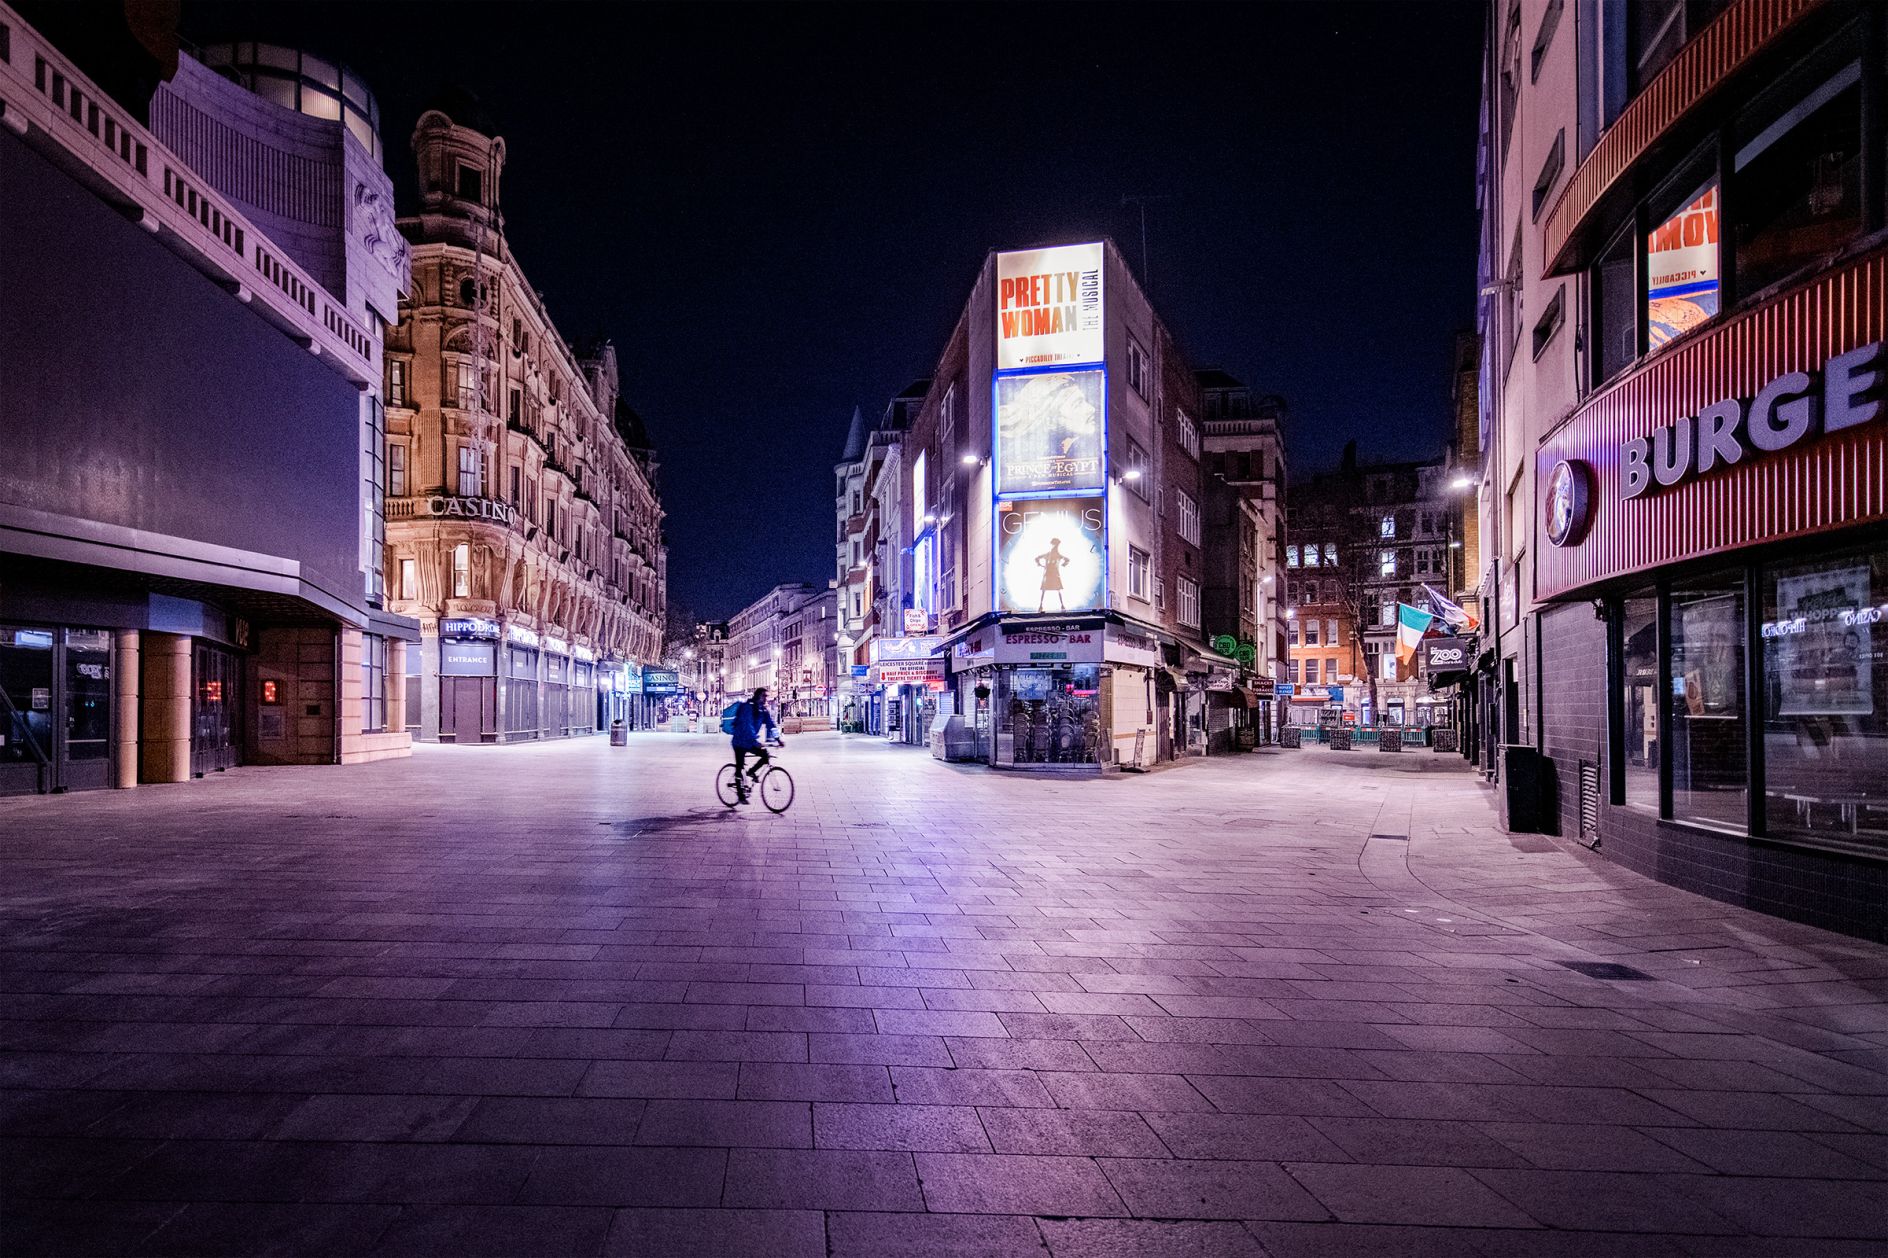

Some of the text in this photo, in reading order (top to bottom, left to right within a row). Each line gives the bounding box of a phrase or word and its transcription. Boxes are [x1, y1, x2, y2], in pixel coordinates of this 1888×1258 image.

[1001, 271, 1080, 310] PRETTY
[1082, 269, 1098, 331] THE MUSICAL
[1001, 305, 1078, 339] WOMAN
[1025, 353, 1053, 364] PICCADILLY
[1620, 341, 1882, 501] BURGE
[1006, 463, 1051, 477] PRINCE
[1057, 460, 1099, 473] EGYPT
[426, 495, 517, 526] CASINO
[1002, 509, 1102, 534] GEUS
[1006, 634, 1059, 644] ESPRESSO
[1069, 634, 1091, 644] BAR
[448, 656, 487, 664] ENTRANCE
[1430, 648, 1462, 665] ZOO
[645, 674, 675, 682] CASINO
